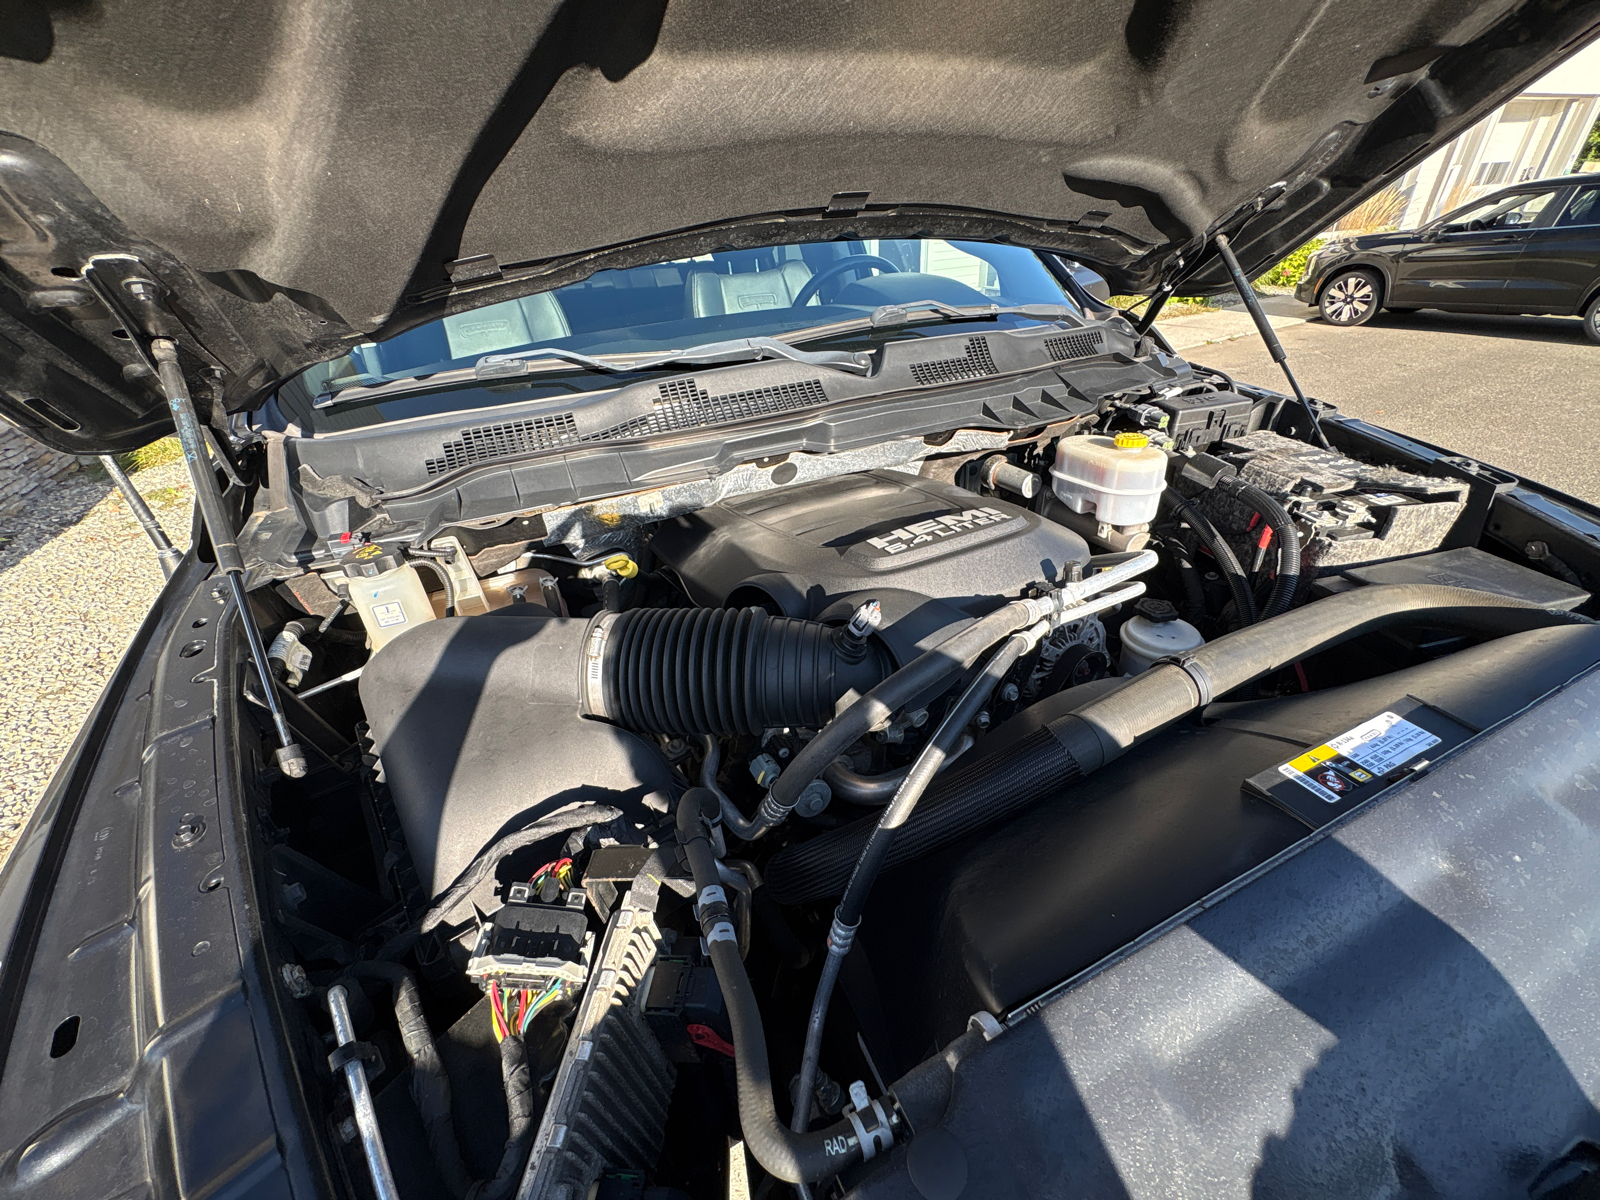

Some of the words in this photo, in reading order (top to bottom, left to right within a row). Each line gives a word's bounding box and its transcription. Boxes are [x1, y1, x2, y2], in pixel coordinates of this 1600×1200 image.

[866, 507, 1002, 549] HEMI
[884, 533, 933, 554] 6.4
[934, 513, 1012, 537] LITER
[823, 1135, 847, 1157] RAD
